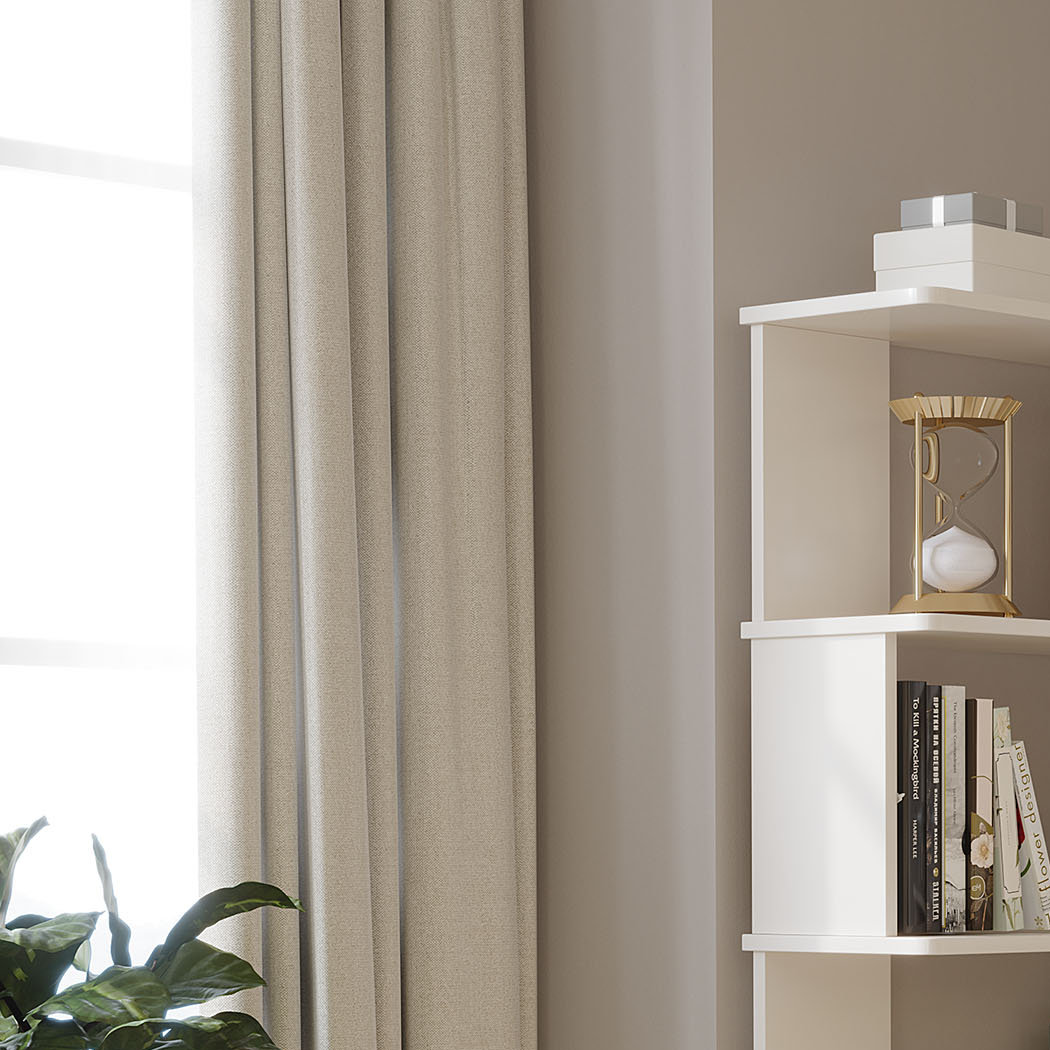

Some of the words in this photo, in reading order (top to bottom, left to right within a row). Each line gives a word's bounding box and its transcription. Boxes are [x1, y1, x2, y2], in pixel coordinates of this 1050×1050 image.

[912, 712, 920, 727] Kill
[913, 697, 920, 710] To
[911, 738, 920, 800] Mockingbird
[1014, 744, 1036, 824] designer
[1034, 832, 1050, 892] flower
